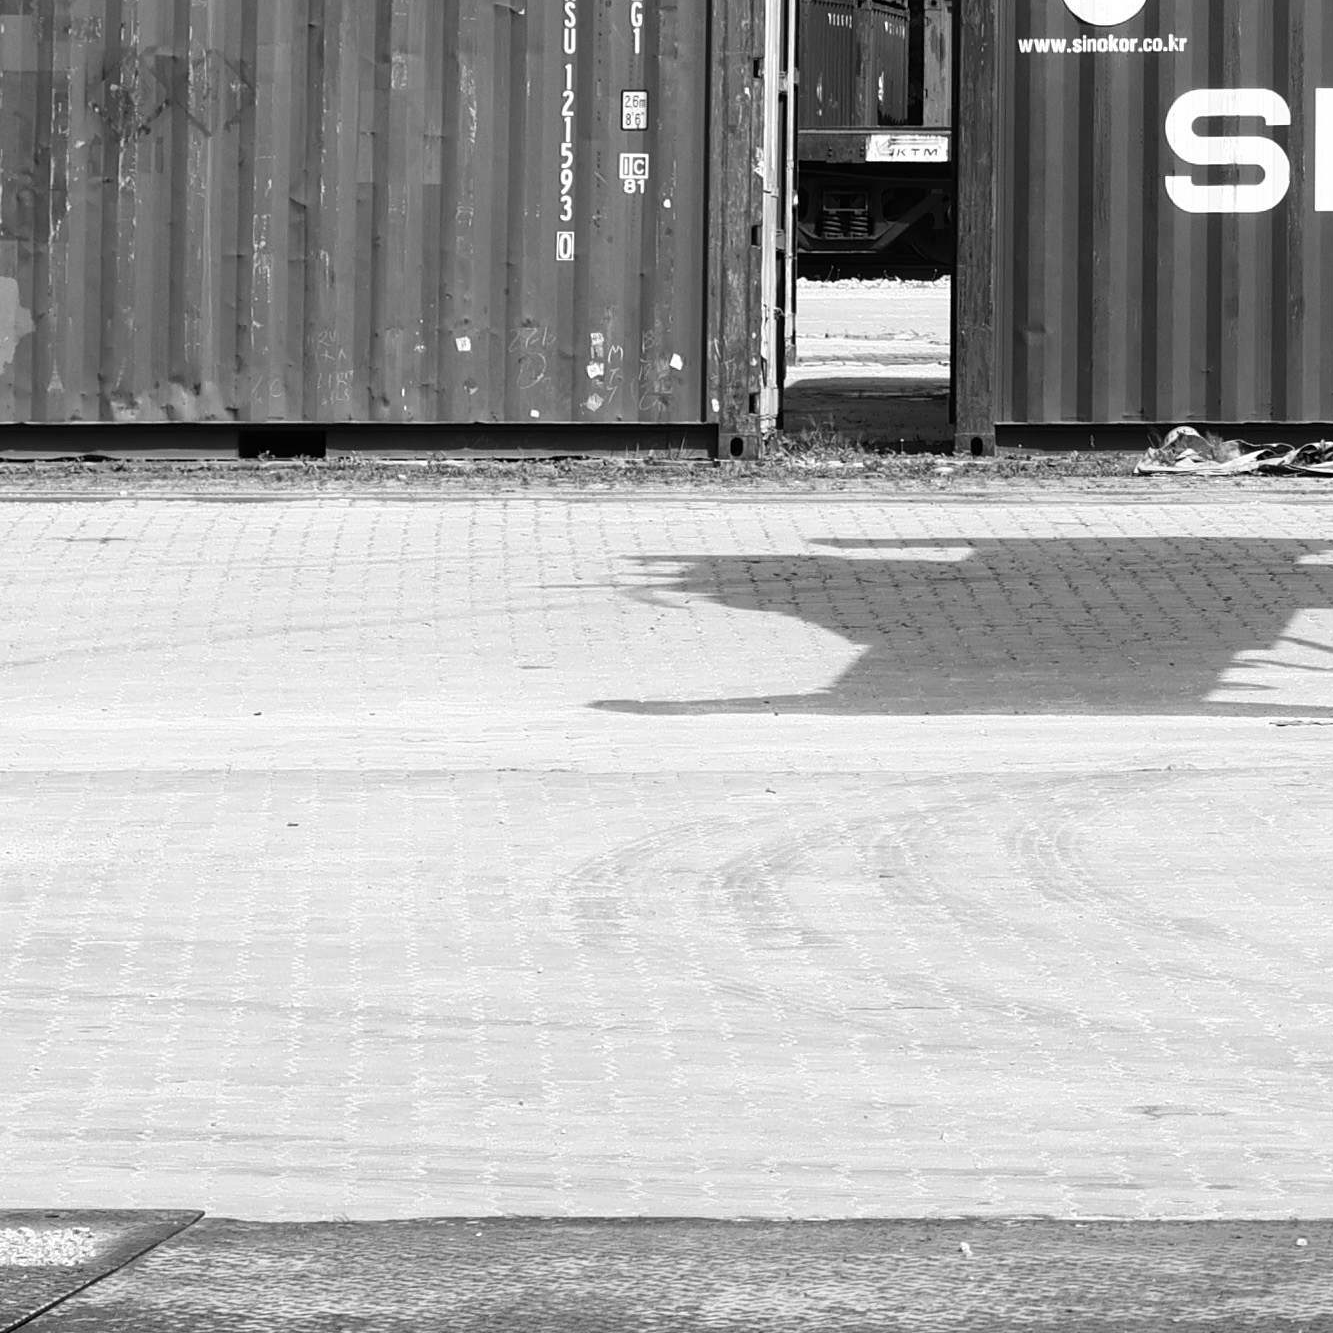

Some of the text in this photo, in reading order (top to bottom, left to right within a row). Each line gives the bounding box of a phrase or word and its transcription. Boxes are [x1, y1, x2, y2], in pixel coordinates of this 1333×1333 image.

[1018, 34, 1187, 53] www.sinokor.co.kr
[560, 64, 574, 221] 121593
[896, 148, 938, 157] KTM
[623, 179, 645, 194] 81
[559, 234, 571, 258] 0
